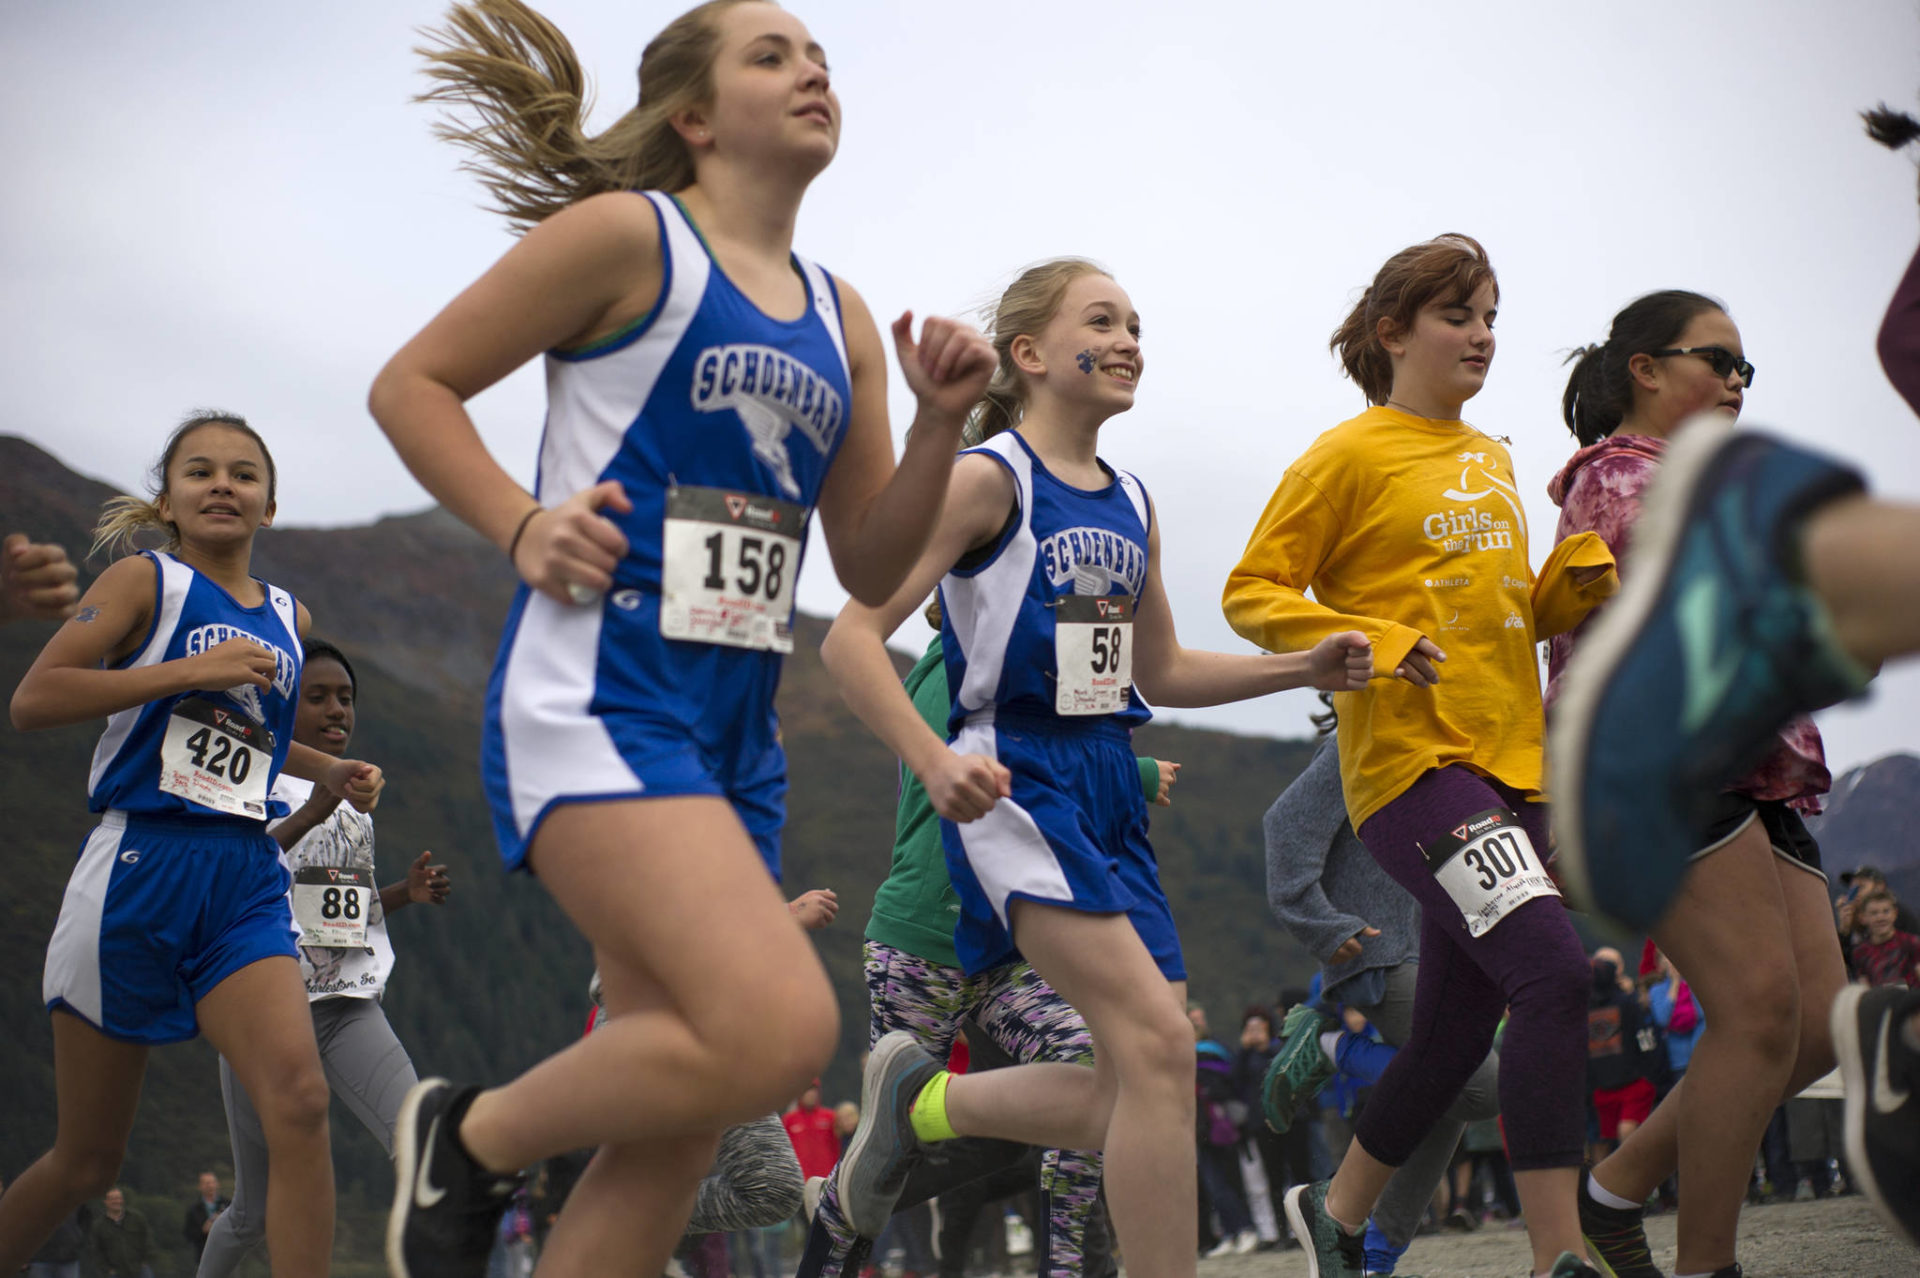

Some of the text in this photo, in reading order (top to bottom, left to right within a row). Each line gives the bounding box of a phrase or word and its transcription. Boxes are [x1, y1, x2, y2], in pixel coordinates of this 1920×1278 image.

[692, 346, 842, 455] SCHOENBAR
[1423, 507, 1509, 540] Girls on
[1442, 531, 1512, 553] the run
[704, 530, 786, 601] 158
[1041, 528, 1145, 595] SCHOENBAR
[1435, 578, 1470, 588] ATHLETA
[187, 624, 295, 698] SCHAR
[1090, 627, 1121, 674] 58
[186, 727, 252, 785] 420
[1464, 831, 1529, 891] 307
[321, 887, 360, 919] 88
[305, 978, 357, 993] harleston,
